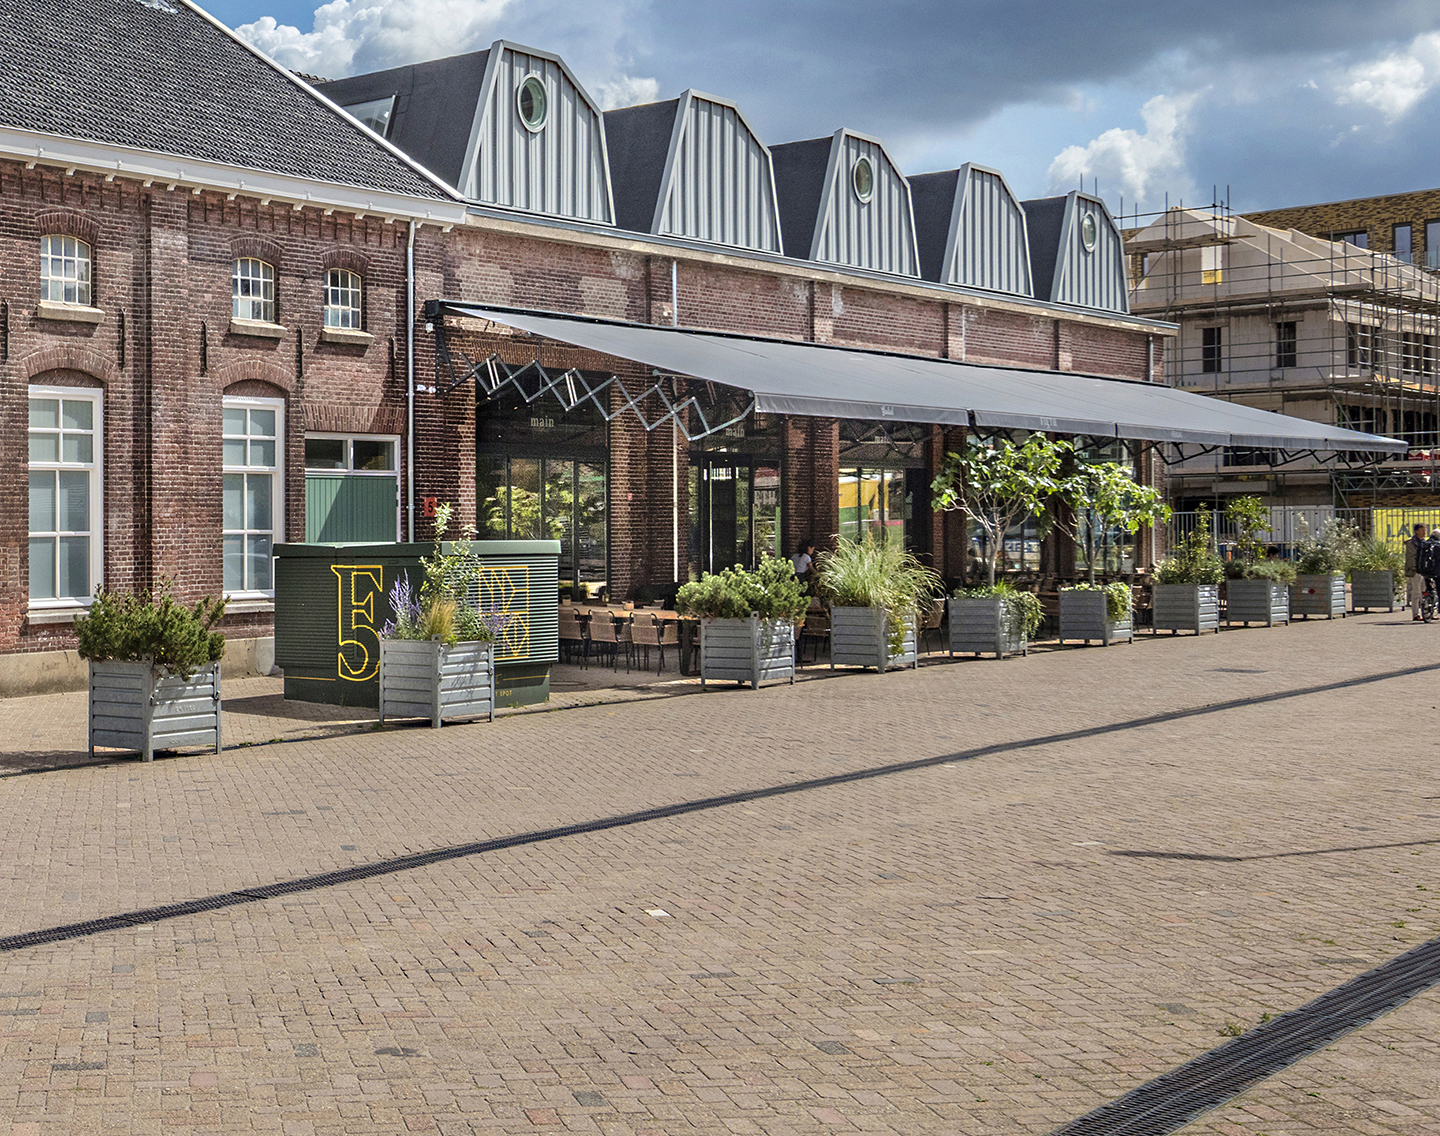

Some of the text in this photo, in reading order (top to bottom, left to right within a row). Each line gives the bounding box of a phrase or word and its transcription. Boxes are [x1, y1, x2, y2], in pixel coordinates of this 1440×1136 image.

[530, 415, 554, 427] main
[427, 501, 434, 513] 5
[499, 689, 512, 697] SPOT
